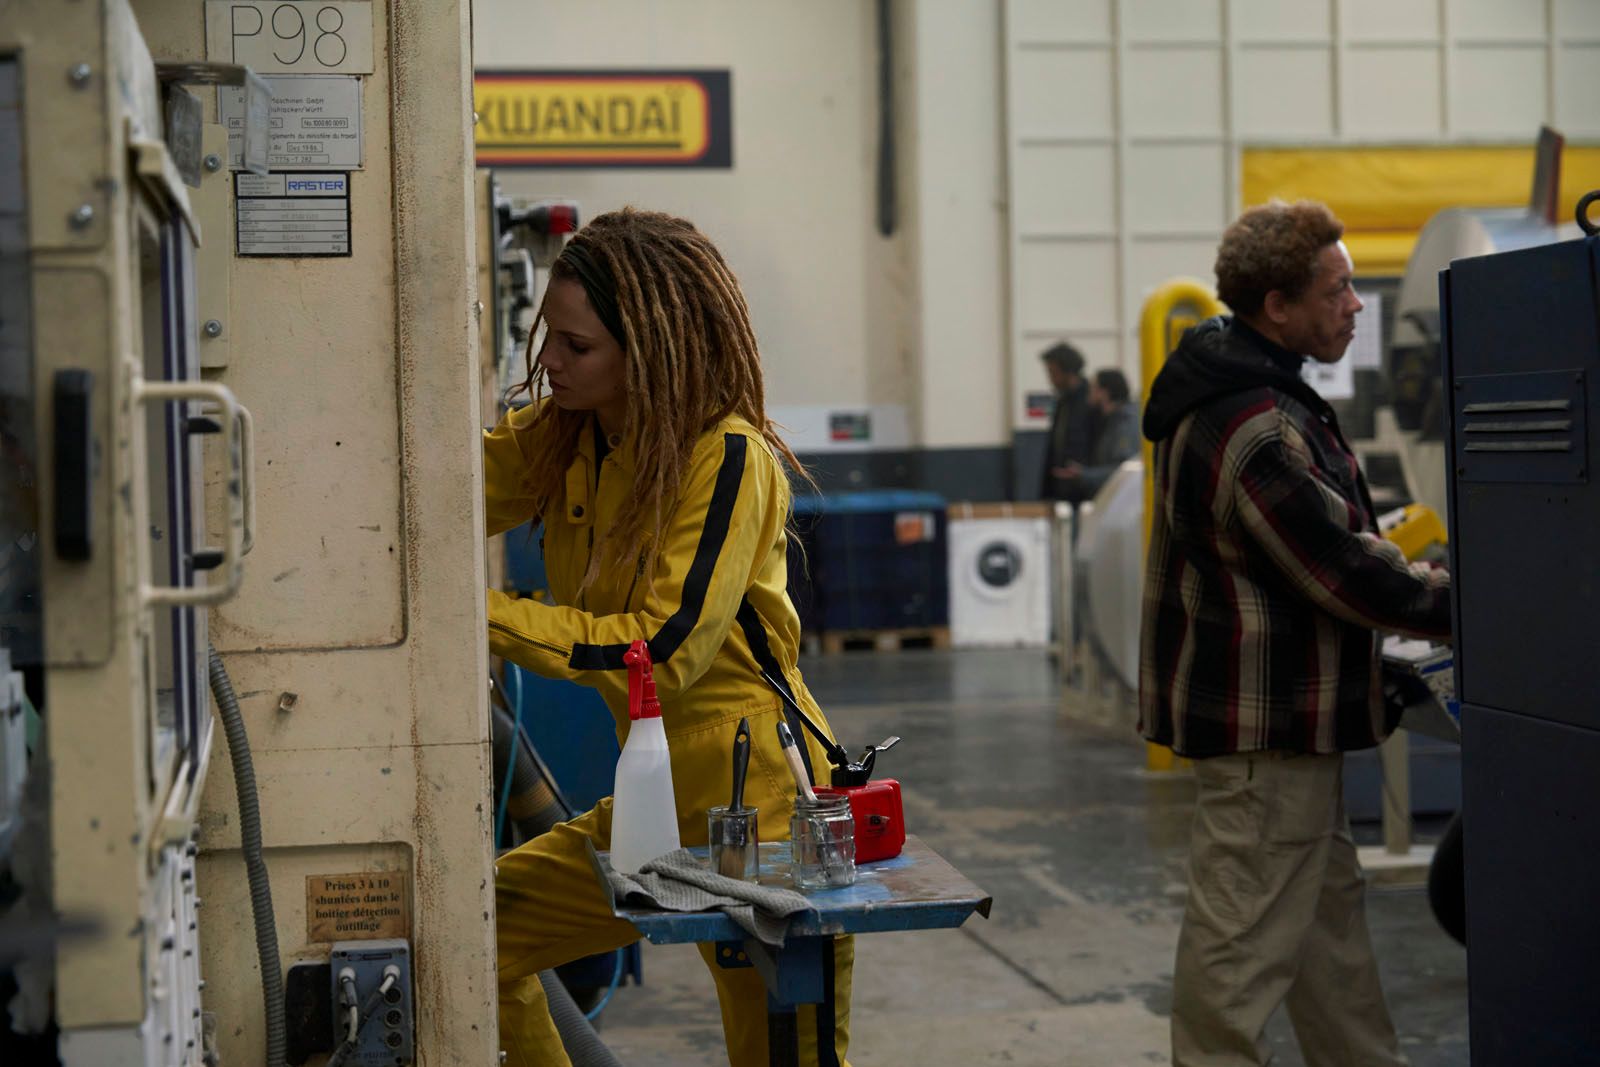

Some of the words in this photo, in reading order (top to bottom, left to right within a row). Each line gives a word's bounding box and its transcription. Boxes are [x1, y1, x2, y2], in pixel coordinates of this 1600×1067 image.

[231, 3, 347, 67] P98
[288, 181, 344, 190] RASTER
[325, 880, 356, 891] Prises
[358, 880, 365, 890] 3
[378, 879, 390, 889] 10
[315, 893, 360, 905] shuntées
[363, 892, 388, 903] dans
[391, 892, 400, 901] le
[352, 906, 400, 918] détection
[336, 920, 381, 932] outillage
